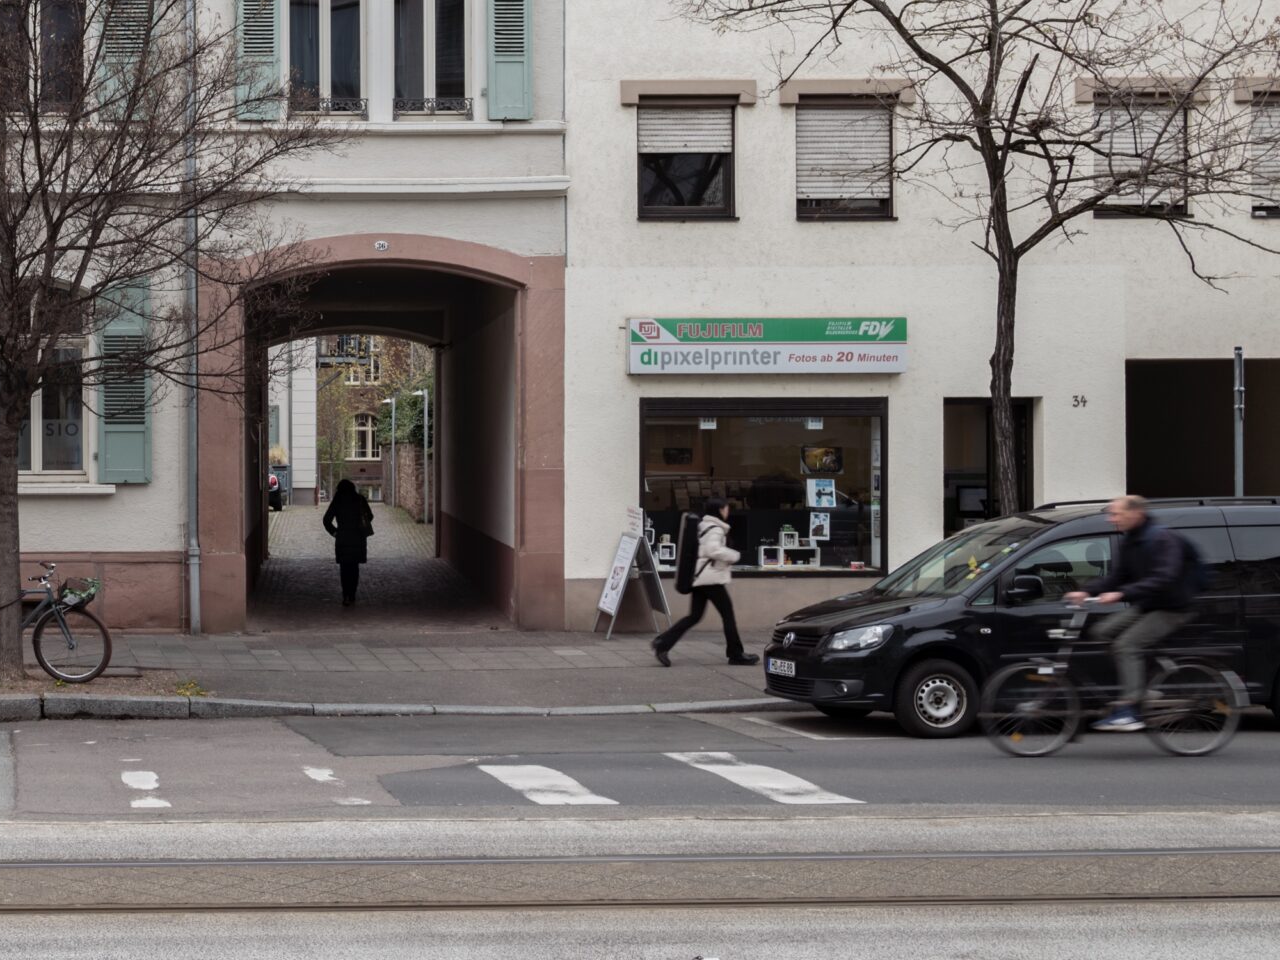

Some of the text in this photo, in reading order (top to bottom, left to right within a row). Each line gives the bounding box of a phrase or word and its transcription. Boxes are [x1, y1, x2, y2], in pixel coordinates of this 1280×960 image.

[677, 323, 763, 338] FUJIFILM
[788, 353, 817, 362] Fotos
[820, 353, 833, 362] ab
[836, 351, 854, 362] 20
[857, 353, 898, 362] Minuten
[1072, 395, 1088, 408] 34
[46, 423, 79, 436] SIO
